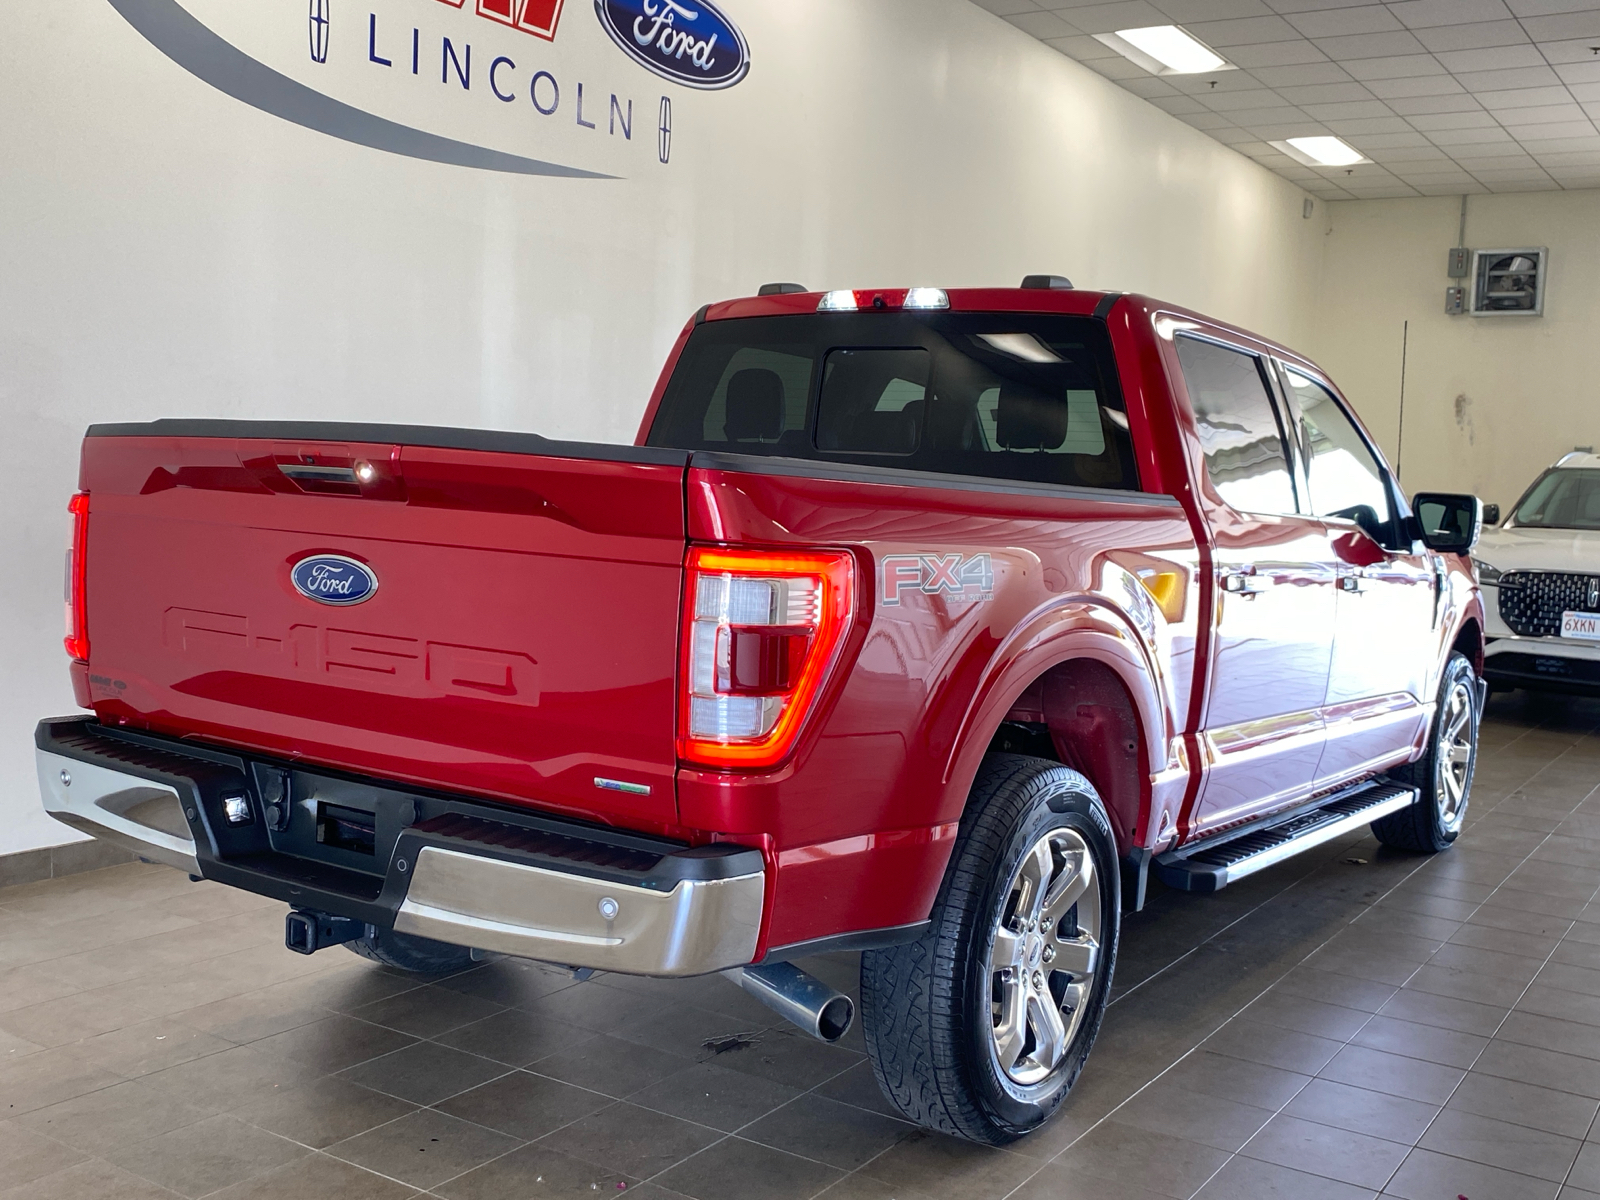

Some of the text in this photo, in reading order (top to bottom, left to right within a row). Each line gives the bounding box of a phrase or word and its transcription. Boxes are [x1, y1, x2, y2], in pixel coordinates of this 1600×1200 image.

[633, 0, 718, 71] Ford
[367, 12, 633, 141] LINCOLN
[307, 564, 354, 595] Ford
[881, 553, 994, 608] FX4
[162, 606, 541, 707] F-150
[1564, 618, 1596, 633] 6XKN
